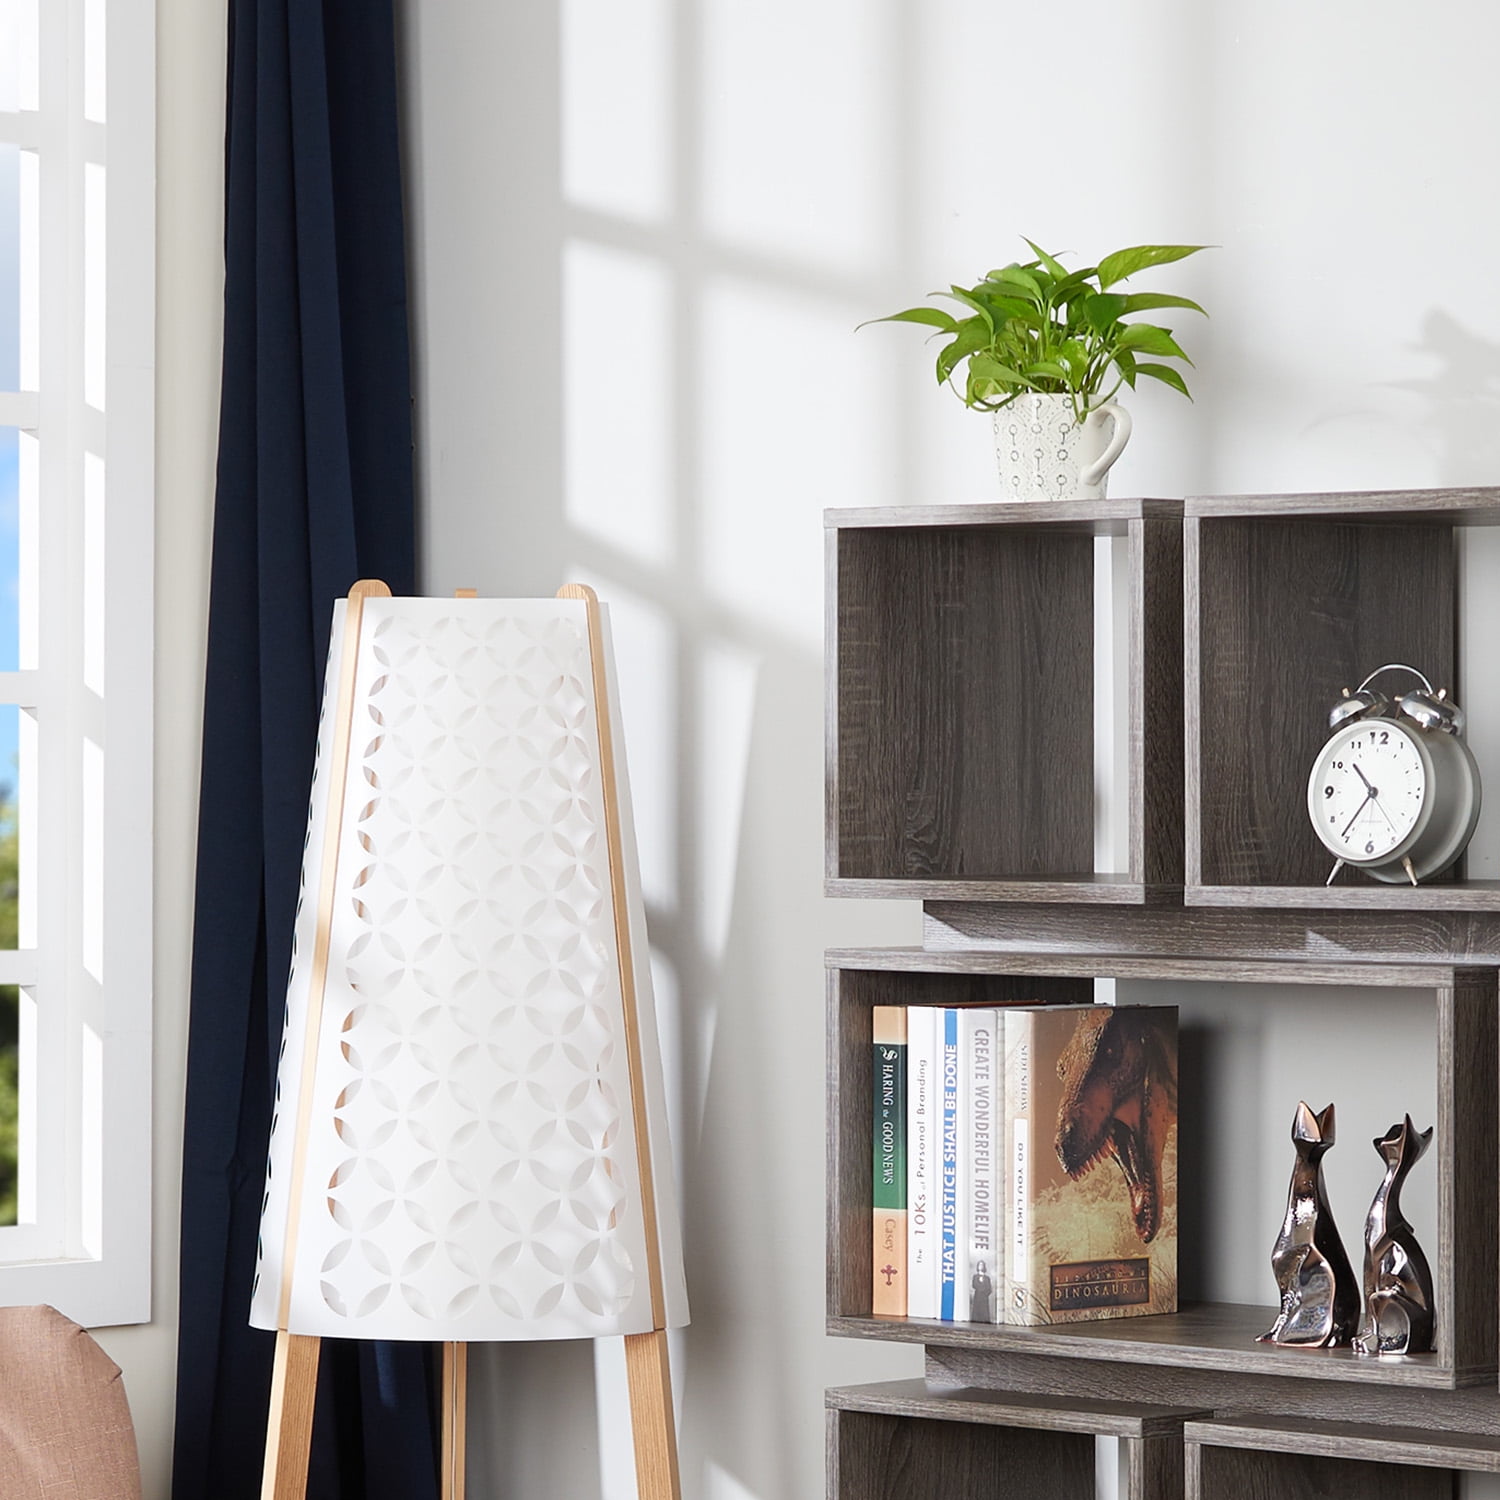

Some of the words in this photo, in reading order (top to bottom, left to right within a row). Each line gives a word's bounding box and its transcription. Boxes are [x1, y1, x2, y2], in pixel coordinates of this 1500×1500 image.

[1351, 741, 1362, 749] 11
[1370, 731, 1389, 745] 12
[1332, 761, 1344, 769] 10
[1325, 786, 1335, 799] 9
[1330, 815, 1335, 823] 8
[1365, 839, 1375, 853] 6
[944, 1044, 957, 1088] DONE
[975, 1029, 989, 1080] CREATE
[916, 1059, 927, 1115] Branding
[945, 1091, 957, 1108] BE
[882, 1122, 895, 1152] GOOD
[943, 1113, 957, 1163] SHALL
[975, 1085, 989, 1174] WONDERFUL
[917, 1121, 926, 1178] Personal
[882, 1155, 895, 1185] NEWS
[943, 1166, 956, 1236] JUSTICE
[975, 1179, 989, 1250] HOMELIFE
[883, 1218, 897, 1253] Casey
[943, 1239, 955, 1284] THAT
[1054, 1282, 1146, 1300] DINOSAURIA
